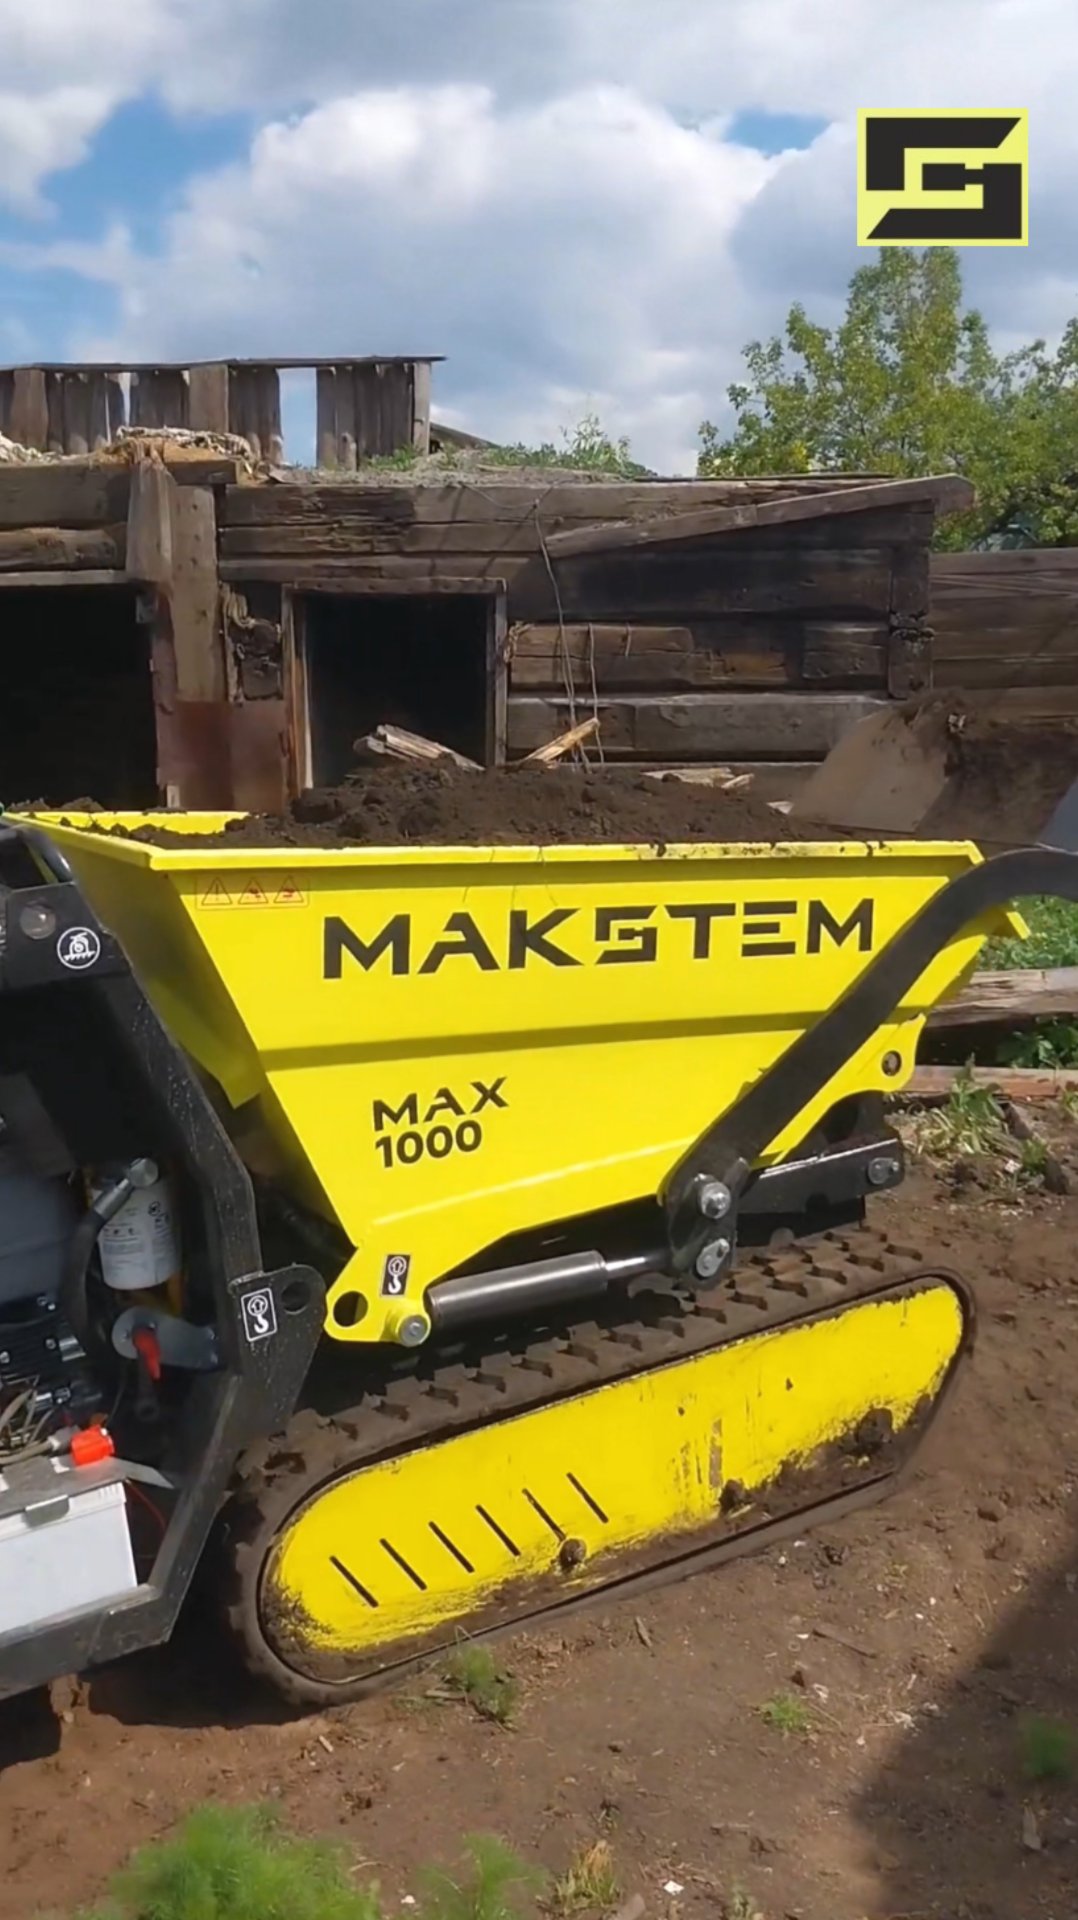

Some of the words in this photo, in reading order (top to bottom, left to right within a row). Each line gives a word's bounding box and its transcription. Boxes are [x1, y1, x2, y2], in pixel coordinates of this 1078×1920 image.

[324, 899, 873, 978] MAKSTEM
[373, 1077, 508, 1131] MAX
[375, 1120, 482, 1168] 1000
